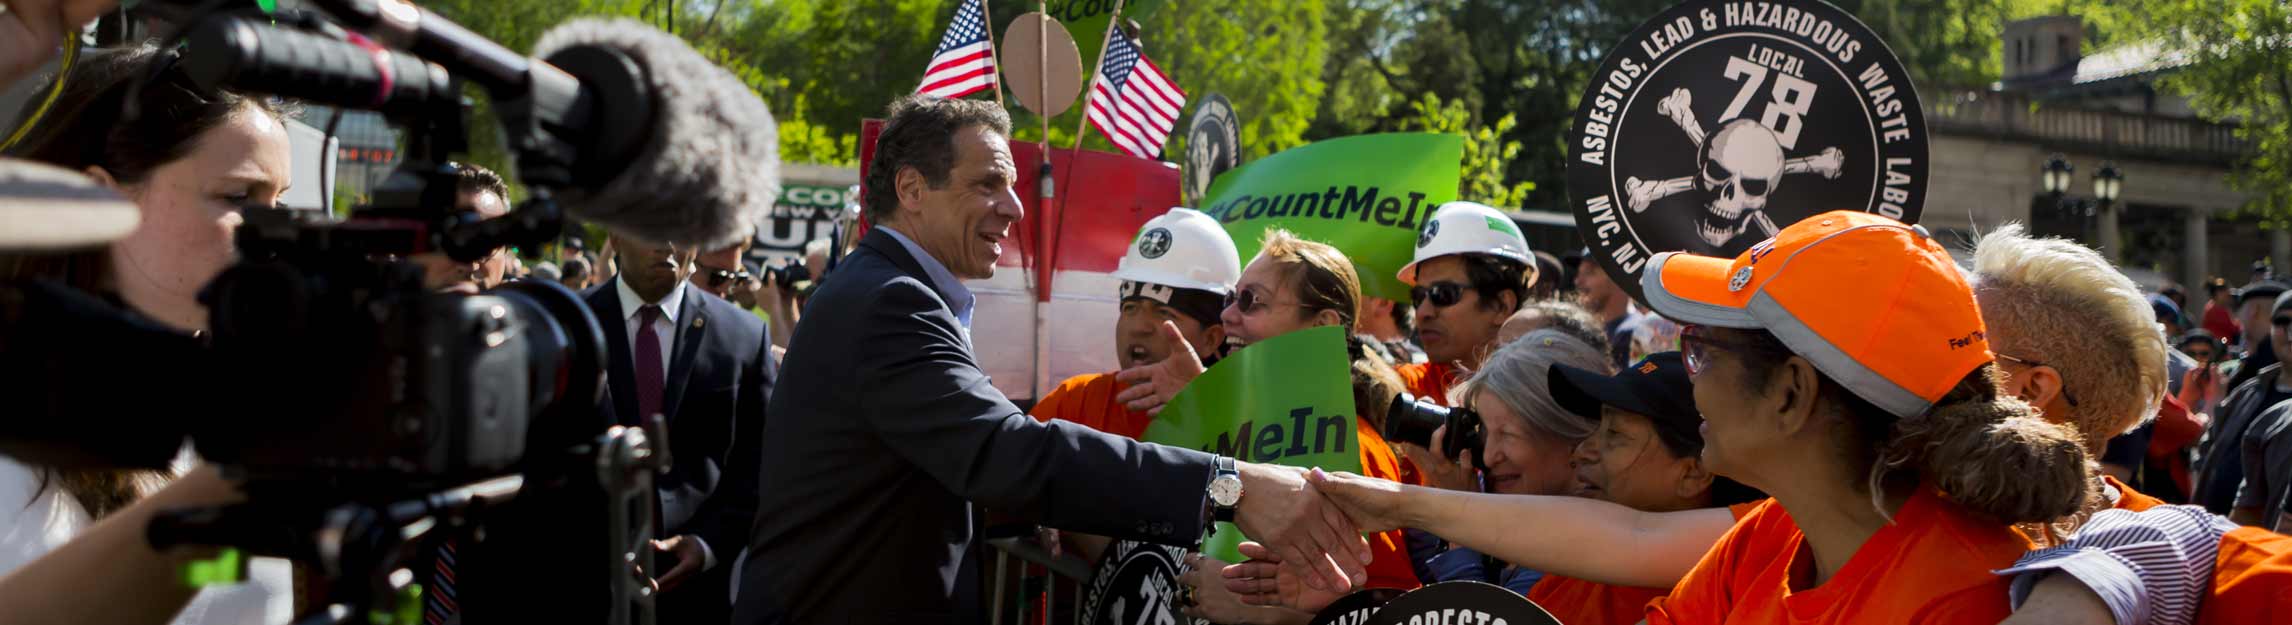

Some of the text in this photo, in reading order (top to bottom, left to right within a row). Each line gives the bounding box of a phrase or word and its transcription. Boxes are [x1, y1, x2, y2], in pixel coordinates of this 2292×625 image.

[1581, 57, 1648, 166] ASBESTOS,
[1640, 16, 1695, 61] LEAD
[1701, 8, 1718, 32] &
[1725, 1, 1862, 63] HAZARDOUS
[1858, 61, 1910, 144] WASTE
[1748, 43, 1805, 78] LOCAL
[1718, 55, 1818, 150] 78
[1202, 406, 1348, 462] MeIn
[1152, 566, 1174, 610] LOCAL
